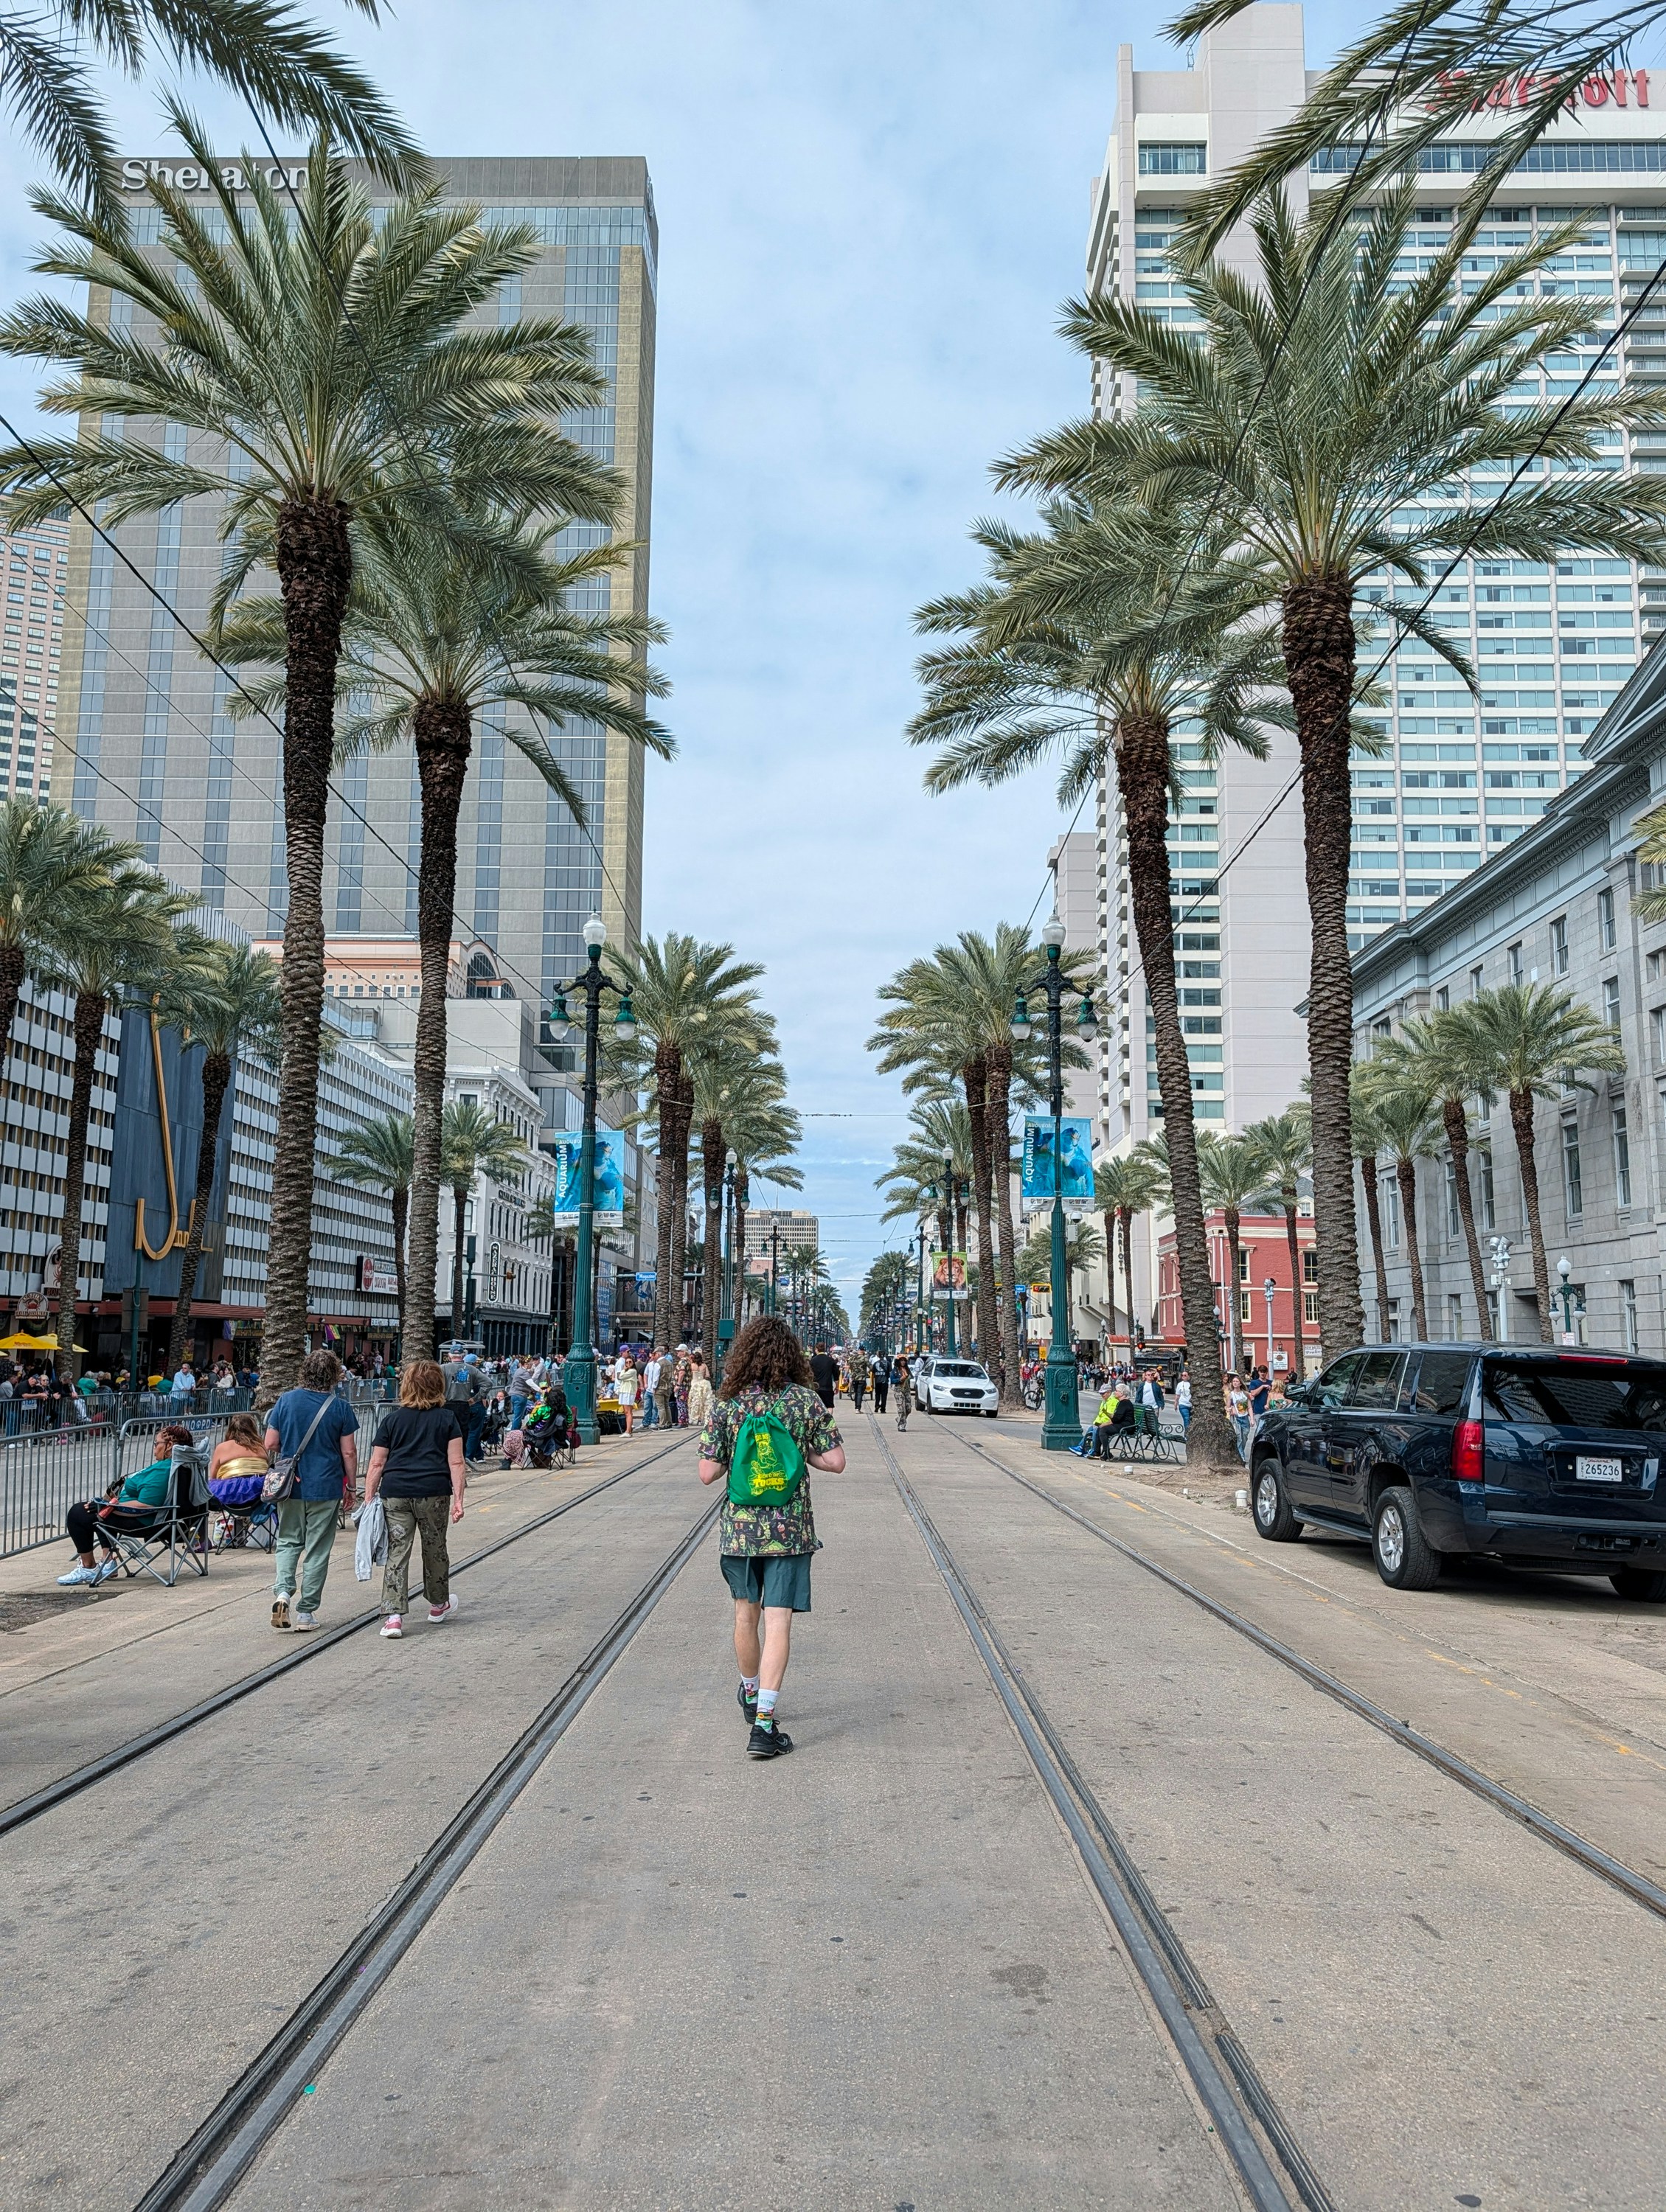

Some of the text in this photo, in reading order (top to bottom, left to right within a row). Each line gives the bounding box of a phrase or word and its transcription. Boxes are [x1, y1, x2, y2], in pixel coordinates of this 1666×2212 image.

[558, 1144, 568, 1197] AQUARIUM
[1025, 1128, 1035, 1183] AQUARIUM
[1585, 1464, 1620, 1476] 265236
